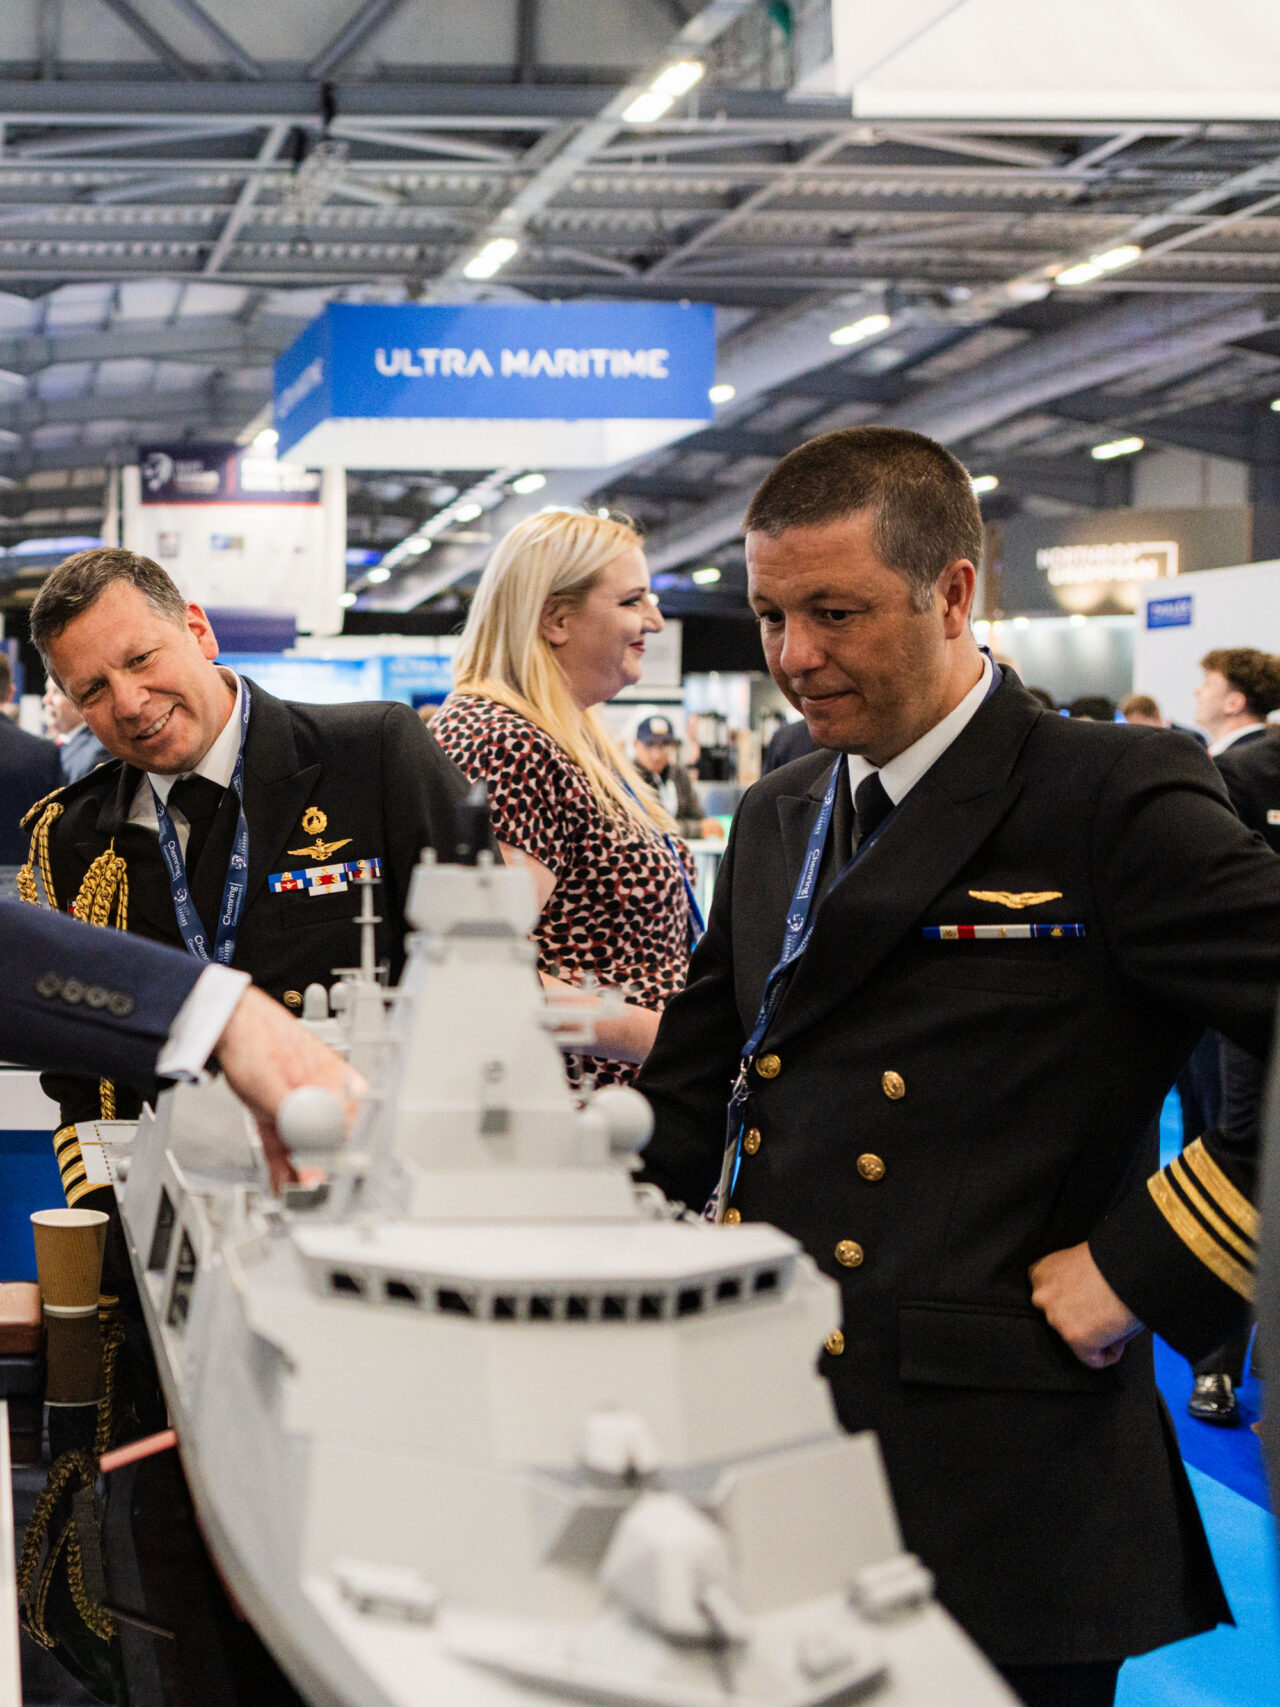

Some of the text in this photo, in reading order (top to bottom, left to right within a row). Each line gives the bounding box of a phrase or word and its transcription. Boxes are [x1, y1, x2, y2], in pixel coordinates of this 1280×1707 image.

[374, 347, 671, 379] ULTRA MARITIME
[167, 840, 182, 878] Chemring
[800, 848, 820, 897] Chemring
[222, 885, 239, 926] Chemring
